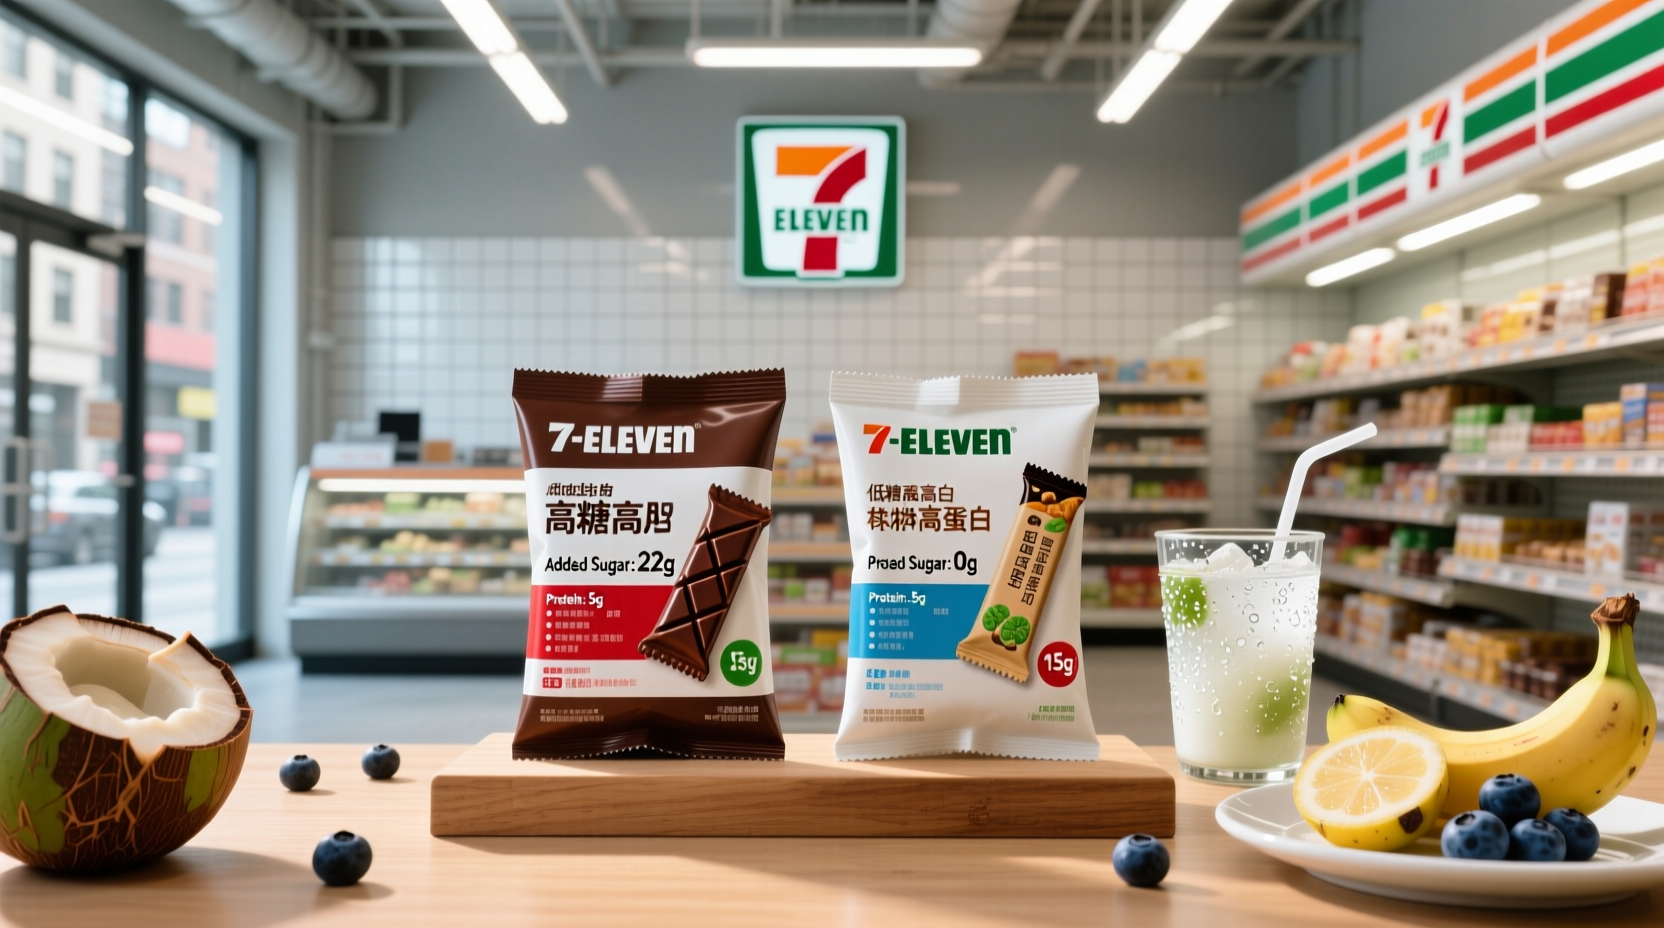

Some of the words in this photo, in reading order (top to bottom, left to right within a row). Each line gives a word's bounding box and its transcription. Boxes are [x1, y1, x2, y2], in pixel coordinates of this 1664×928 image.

[776, 146, 867, 271] 7
[545, 556, 588, 572] Added
[591, 556, 635, 576] Sugar:
[637, 550, 675, 577] 22g
[909, 555, 951, 575] Sugar:
[953, 550, 977, 576] 0g
[588, 591, 603, 608] 5g
[1044, 652, 1073, 676] 15g
